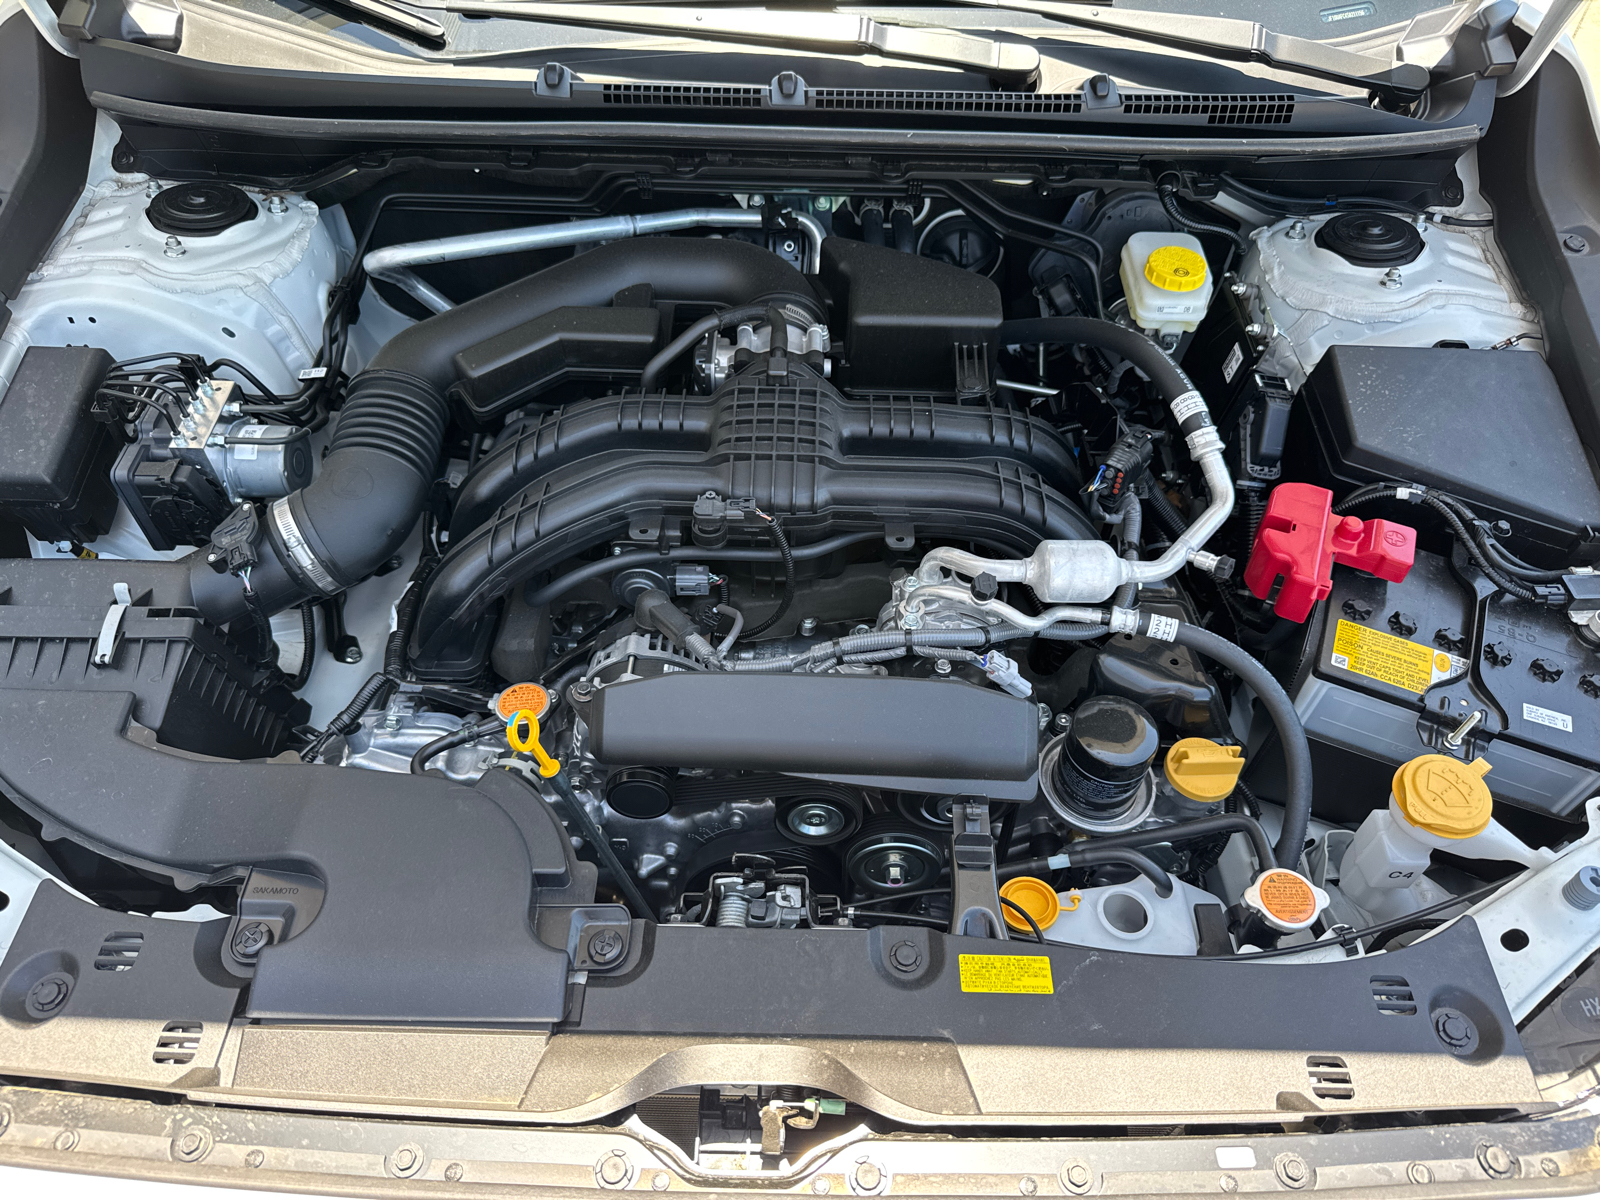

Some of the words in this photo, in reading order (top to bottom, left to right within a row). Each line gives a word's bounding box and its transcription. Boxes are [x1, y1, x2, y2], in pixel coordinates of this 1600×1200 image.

[1339, 620, 1367, 633] DANGER
[1337, 637, 1364, 650] POISON
[1366, 647, 1385, 656] CAUSES
[1409, 802, 1428, 821] PULL
[1388, 871, 1415, 880] C4
[252, 886, 299, 895] SAKAMOTO
[1580, 996, 1600, 1018] HY
